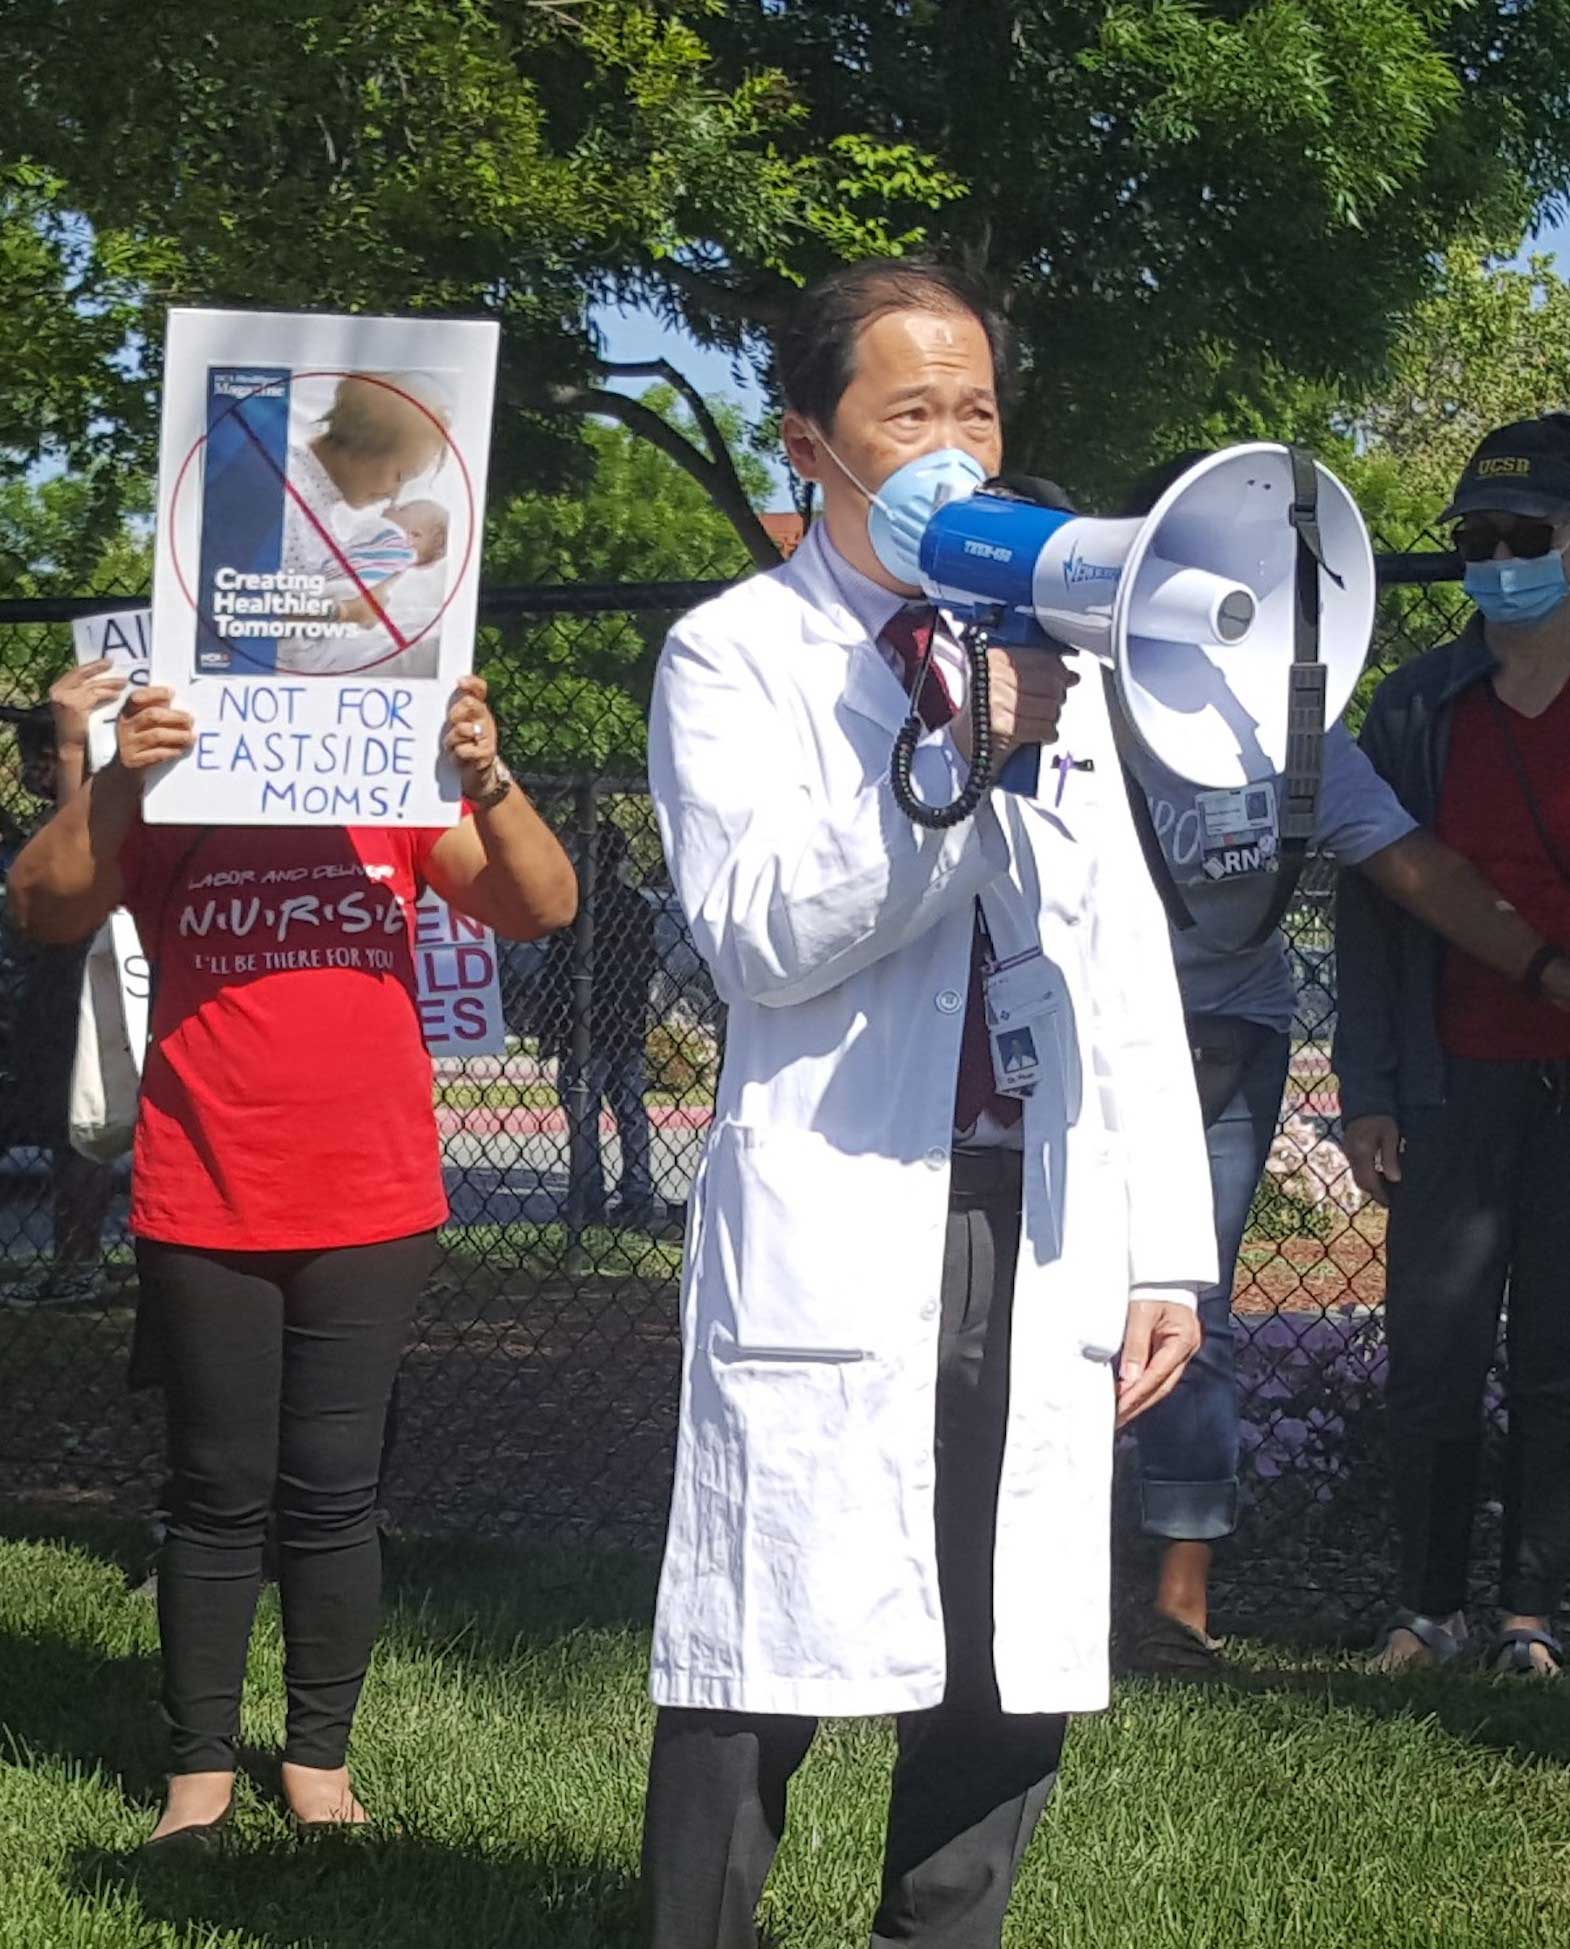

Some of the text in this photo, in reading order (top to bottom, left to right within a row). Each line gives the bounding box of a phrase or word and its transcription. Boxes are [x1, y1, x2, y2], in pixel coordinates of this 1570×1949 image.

[214, 567, 326, 595] Creating
[213, 591, 333, 616] Healthier
[213, 614, 360, 638] Tomorrows
[219, 685, 413, 730] NOT FOR
[197, 732, 416, 776] EASTSIDE
[261, 780, 412, 819] MOMS!
[1223, 847, 1260, 874] RN
[188, 869, 255, 890] LABOR
[261, 867, 309, 884] AND
[235, 953, 257, 972] BE
[263, 951, 321, 969] THERE
[327, 947, 361, 967] FOR
[362, 948, 394, 969] YOU
